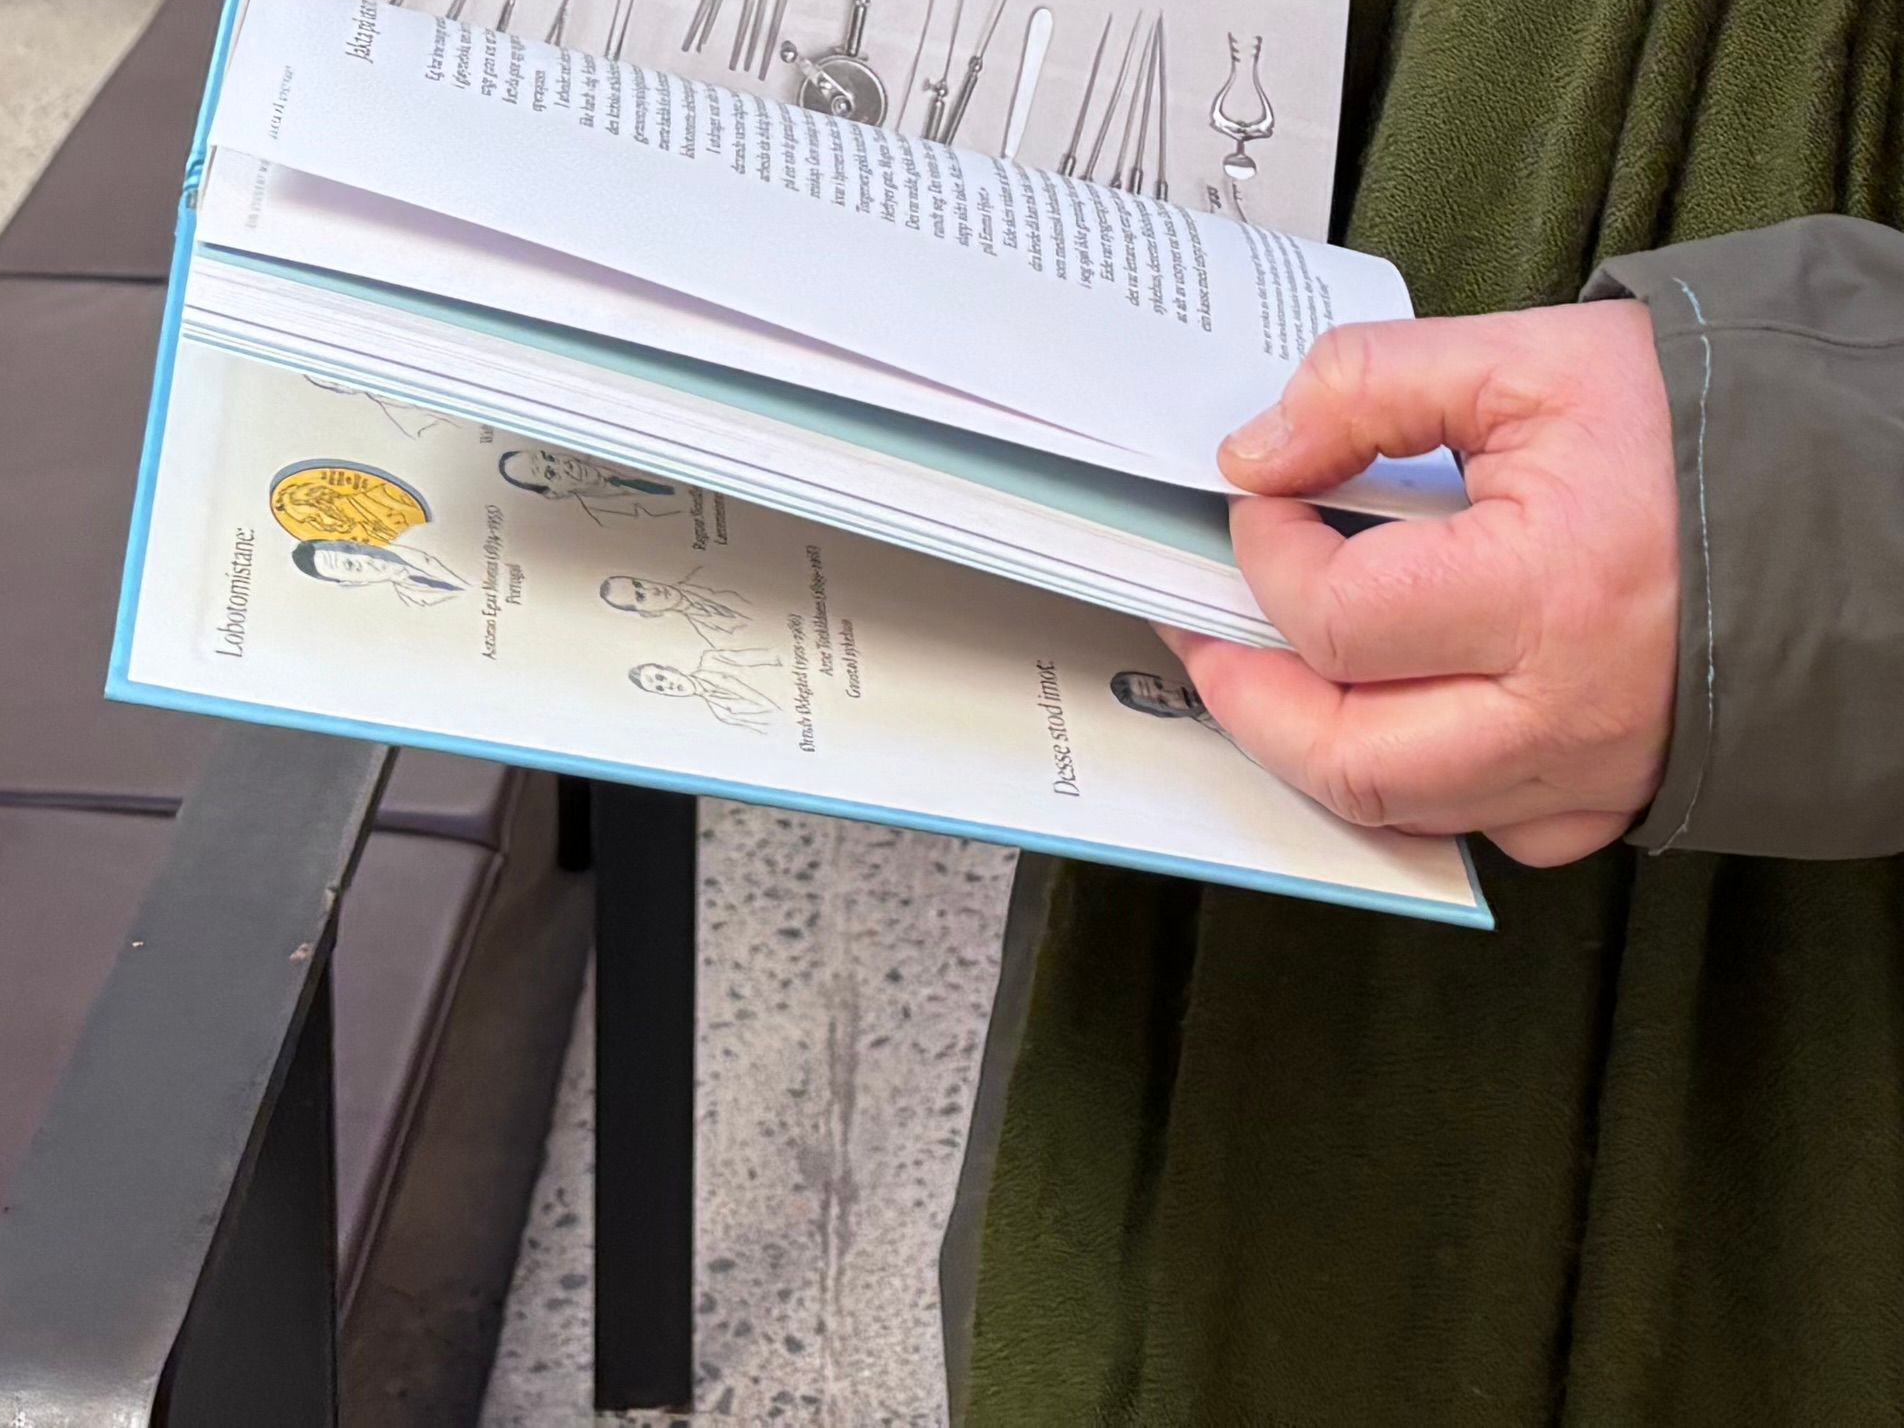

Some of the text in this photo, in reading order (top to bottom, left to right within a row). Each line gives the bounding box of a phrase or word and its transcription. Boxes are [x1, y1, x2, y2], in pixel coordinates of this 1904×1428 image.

[215, 526, 256, 657] Lobotomistane:
[1036, 702, 1069, 742] stod
[1052, 743, 1080, 797] Desse
